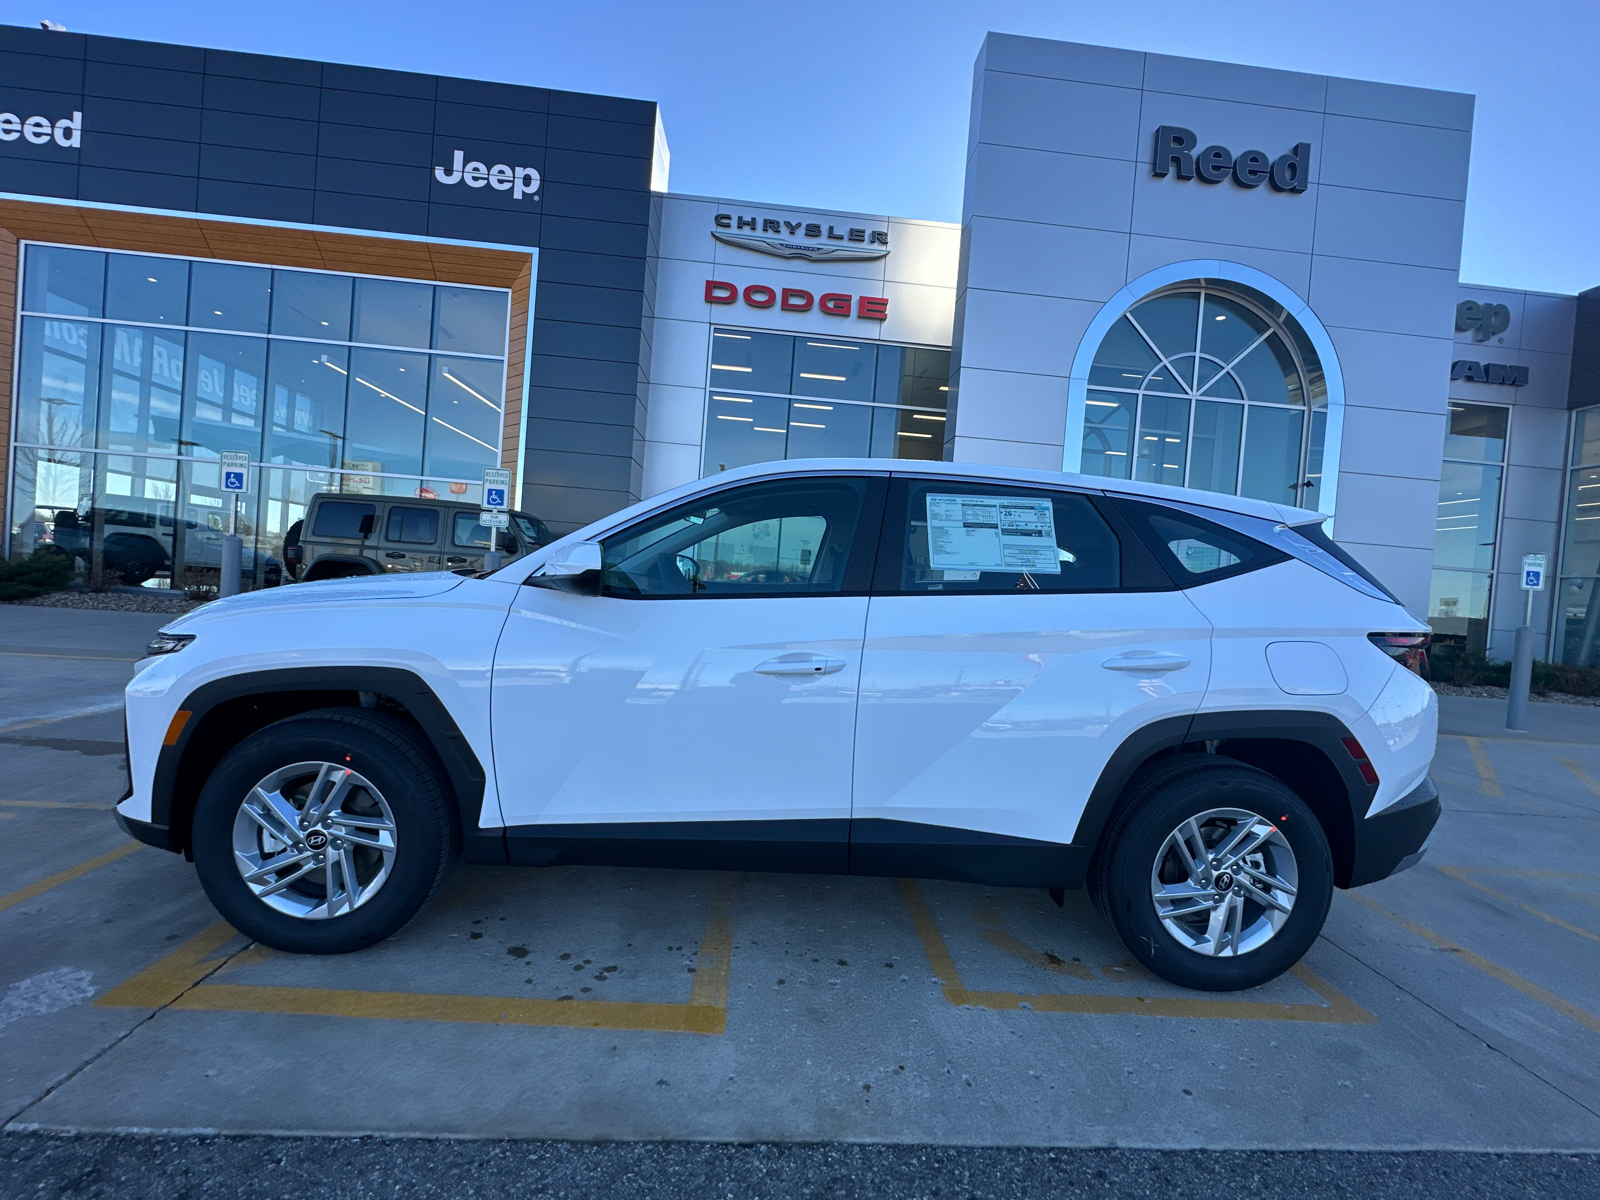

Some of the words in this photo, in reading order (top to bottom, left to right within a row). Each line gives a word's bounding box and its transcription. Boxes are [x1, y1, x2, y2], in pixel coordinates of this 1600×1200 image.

[0, 111, 82, 148] eed
[434, 149, 541, 200] Jeep
[1152, 125, 1311, 194] Reed
[714, 213, 889, 244] CHRYSLER
[704, 280, 889, 320] DODGE
[1450, 360, 1529, 387] AM
[223, 454, 248, 462] RESERVED
[485, 478, 509, 486] PARKING
